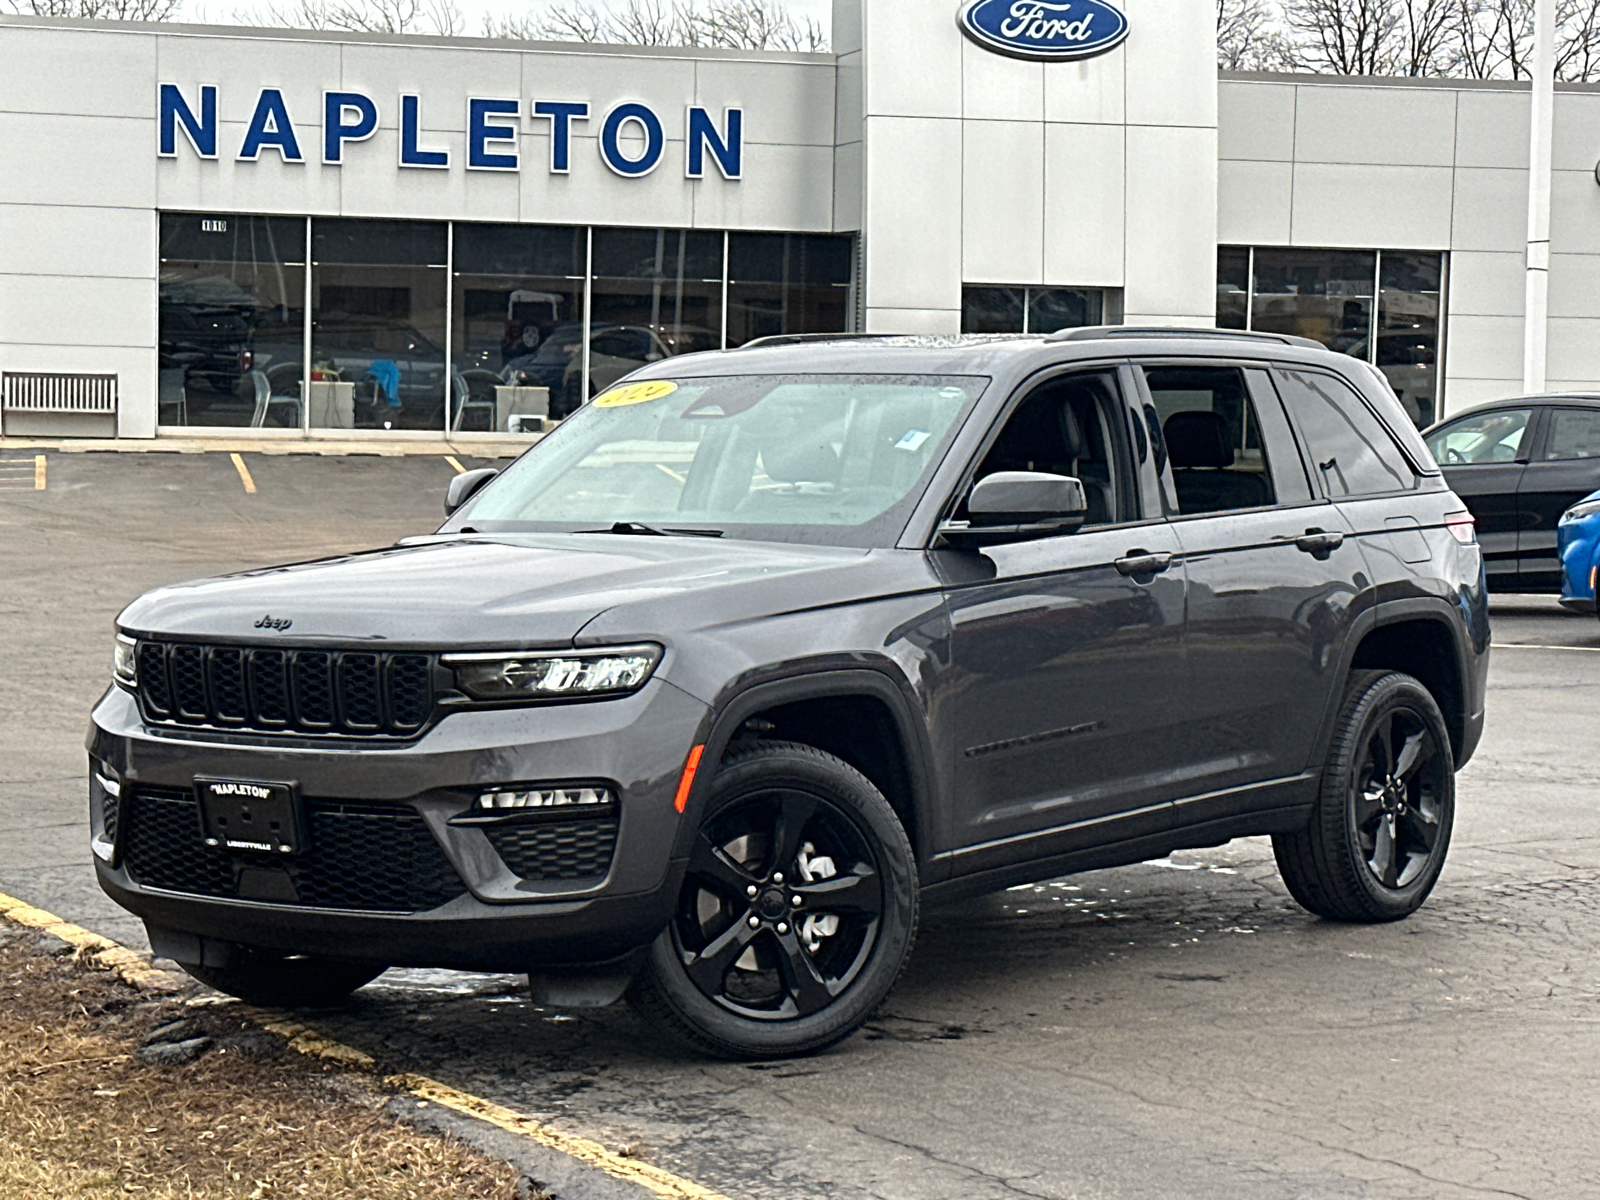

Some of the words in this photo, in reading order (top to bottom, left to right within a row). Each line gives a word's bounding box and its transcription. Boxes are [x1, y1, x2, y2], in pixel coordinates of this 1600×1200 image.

[1001, 0, 1095, 41] Ford
[156, 82, 745, 181] NAPLETON
[253, 614, 293, 632] Jeep
[209, 783, 271, 800] NAPLETON
